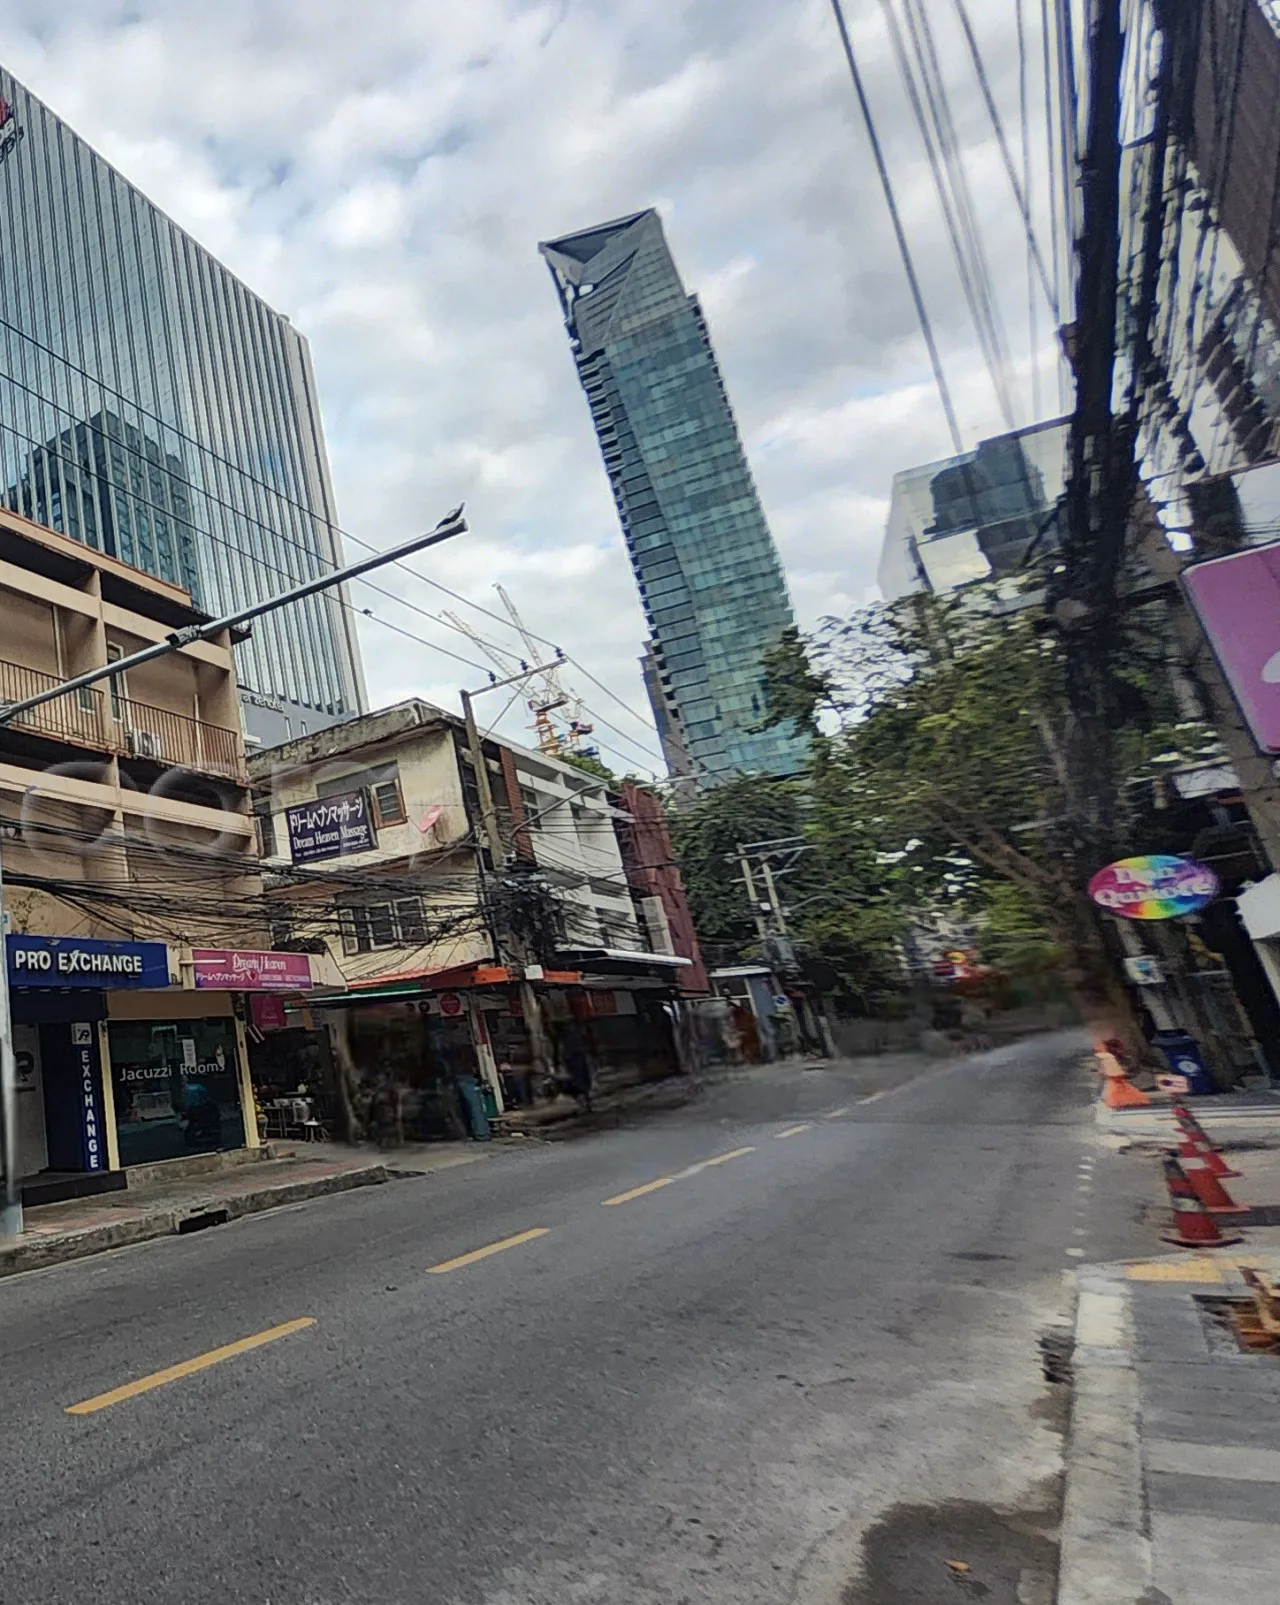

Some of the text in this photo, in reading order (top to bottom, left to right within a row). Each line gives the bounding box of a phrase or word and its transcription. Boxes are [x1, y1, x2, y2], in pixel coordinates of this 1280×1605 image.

[293, 836, 315, 850] Dream
[315, 830, 340, 845] Heaven
[340, 824, 368, 841] Massage
[15, 950, 143, 973] PRO EXCHANGE
[120, 1062, 225, 1082] Jacuzzi Rooms
[81, 1050, 99, 1168] EXCHANGE
